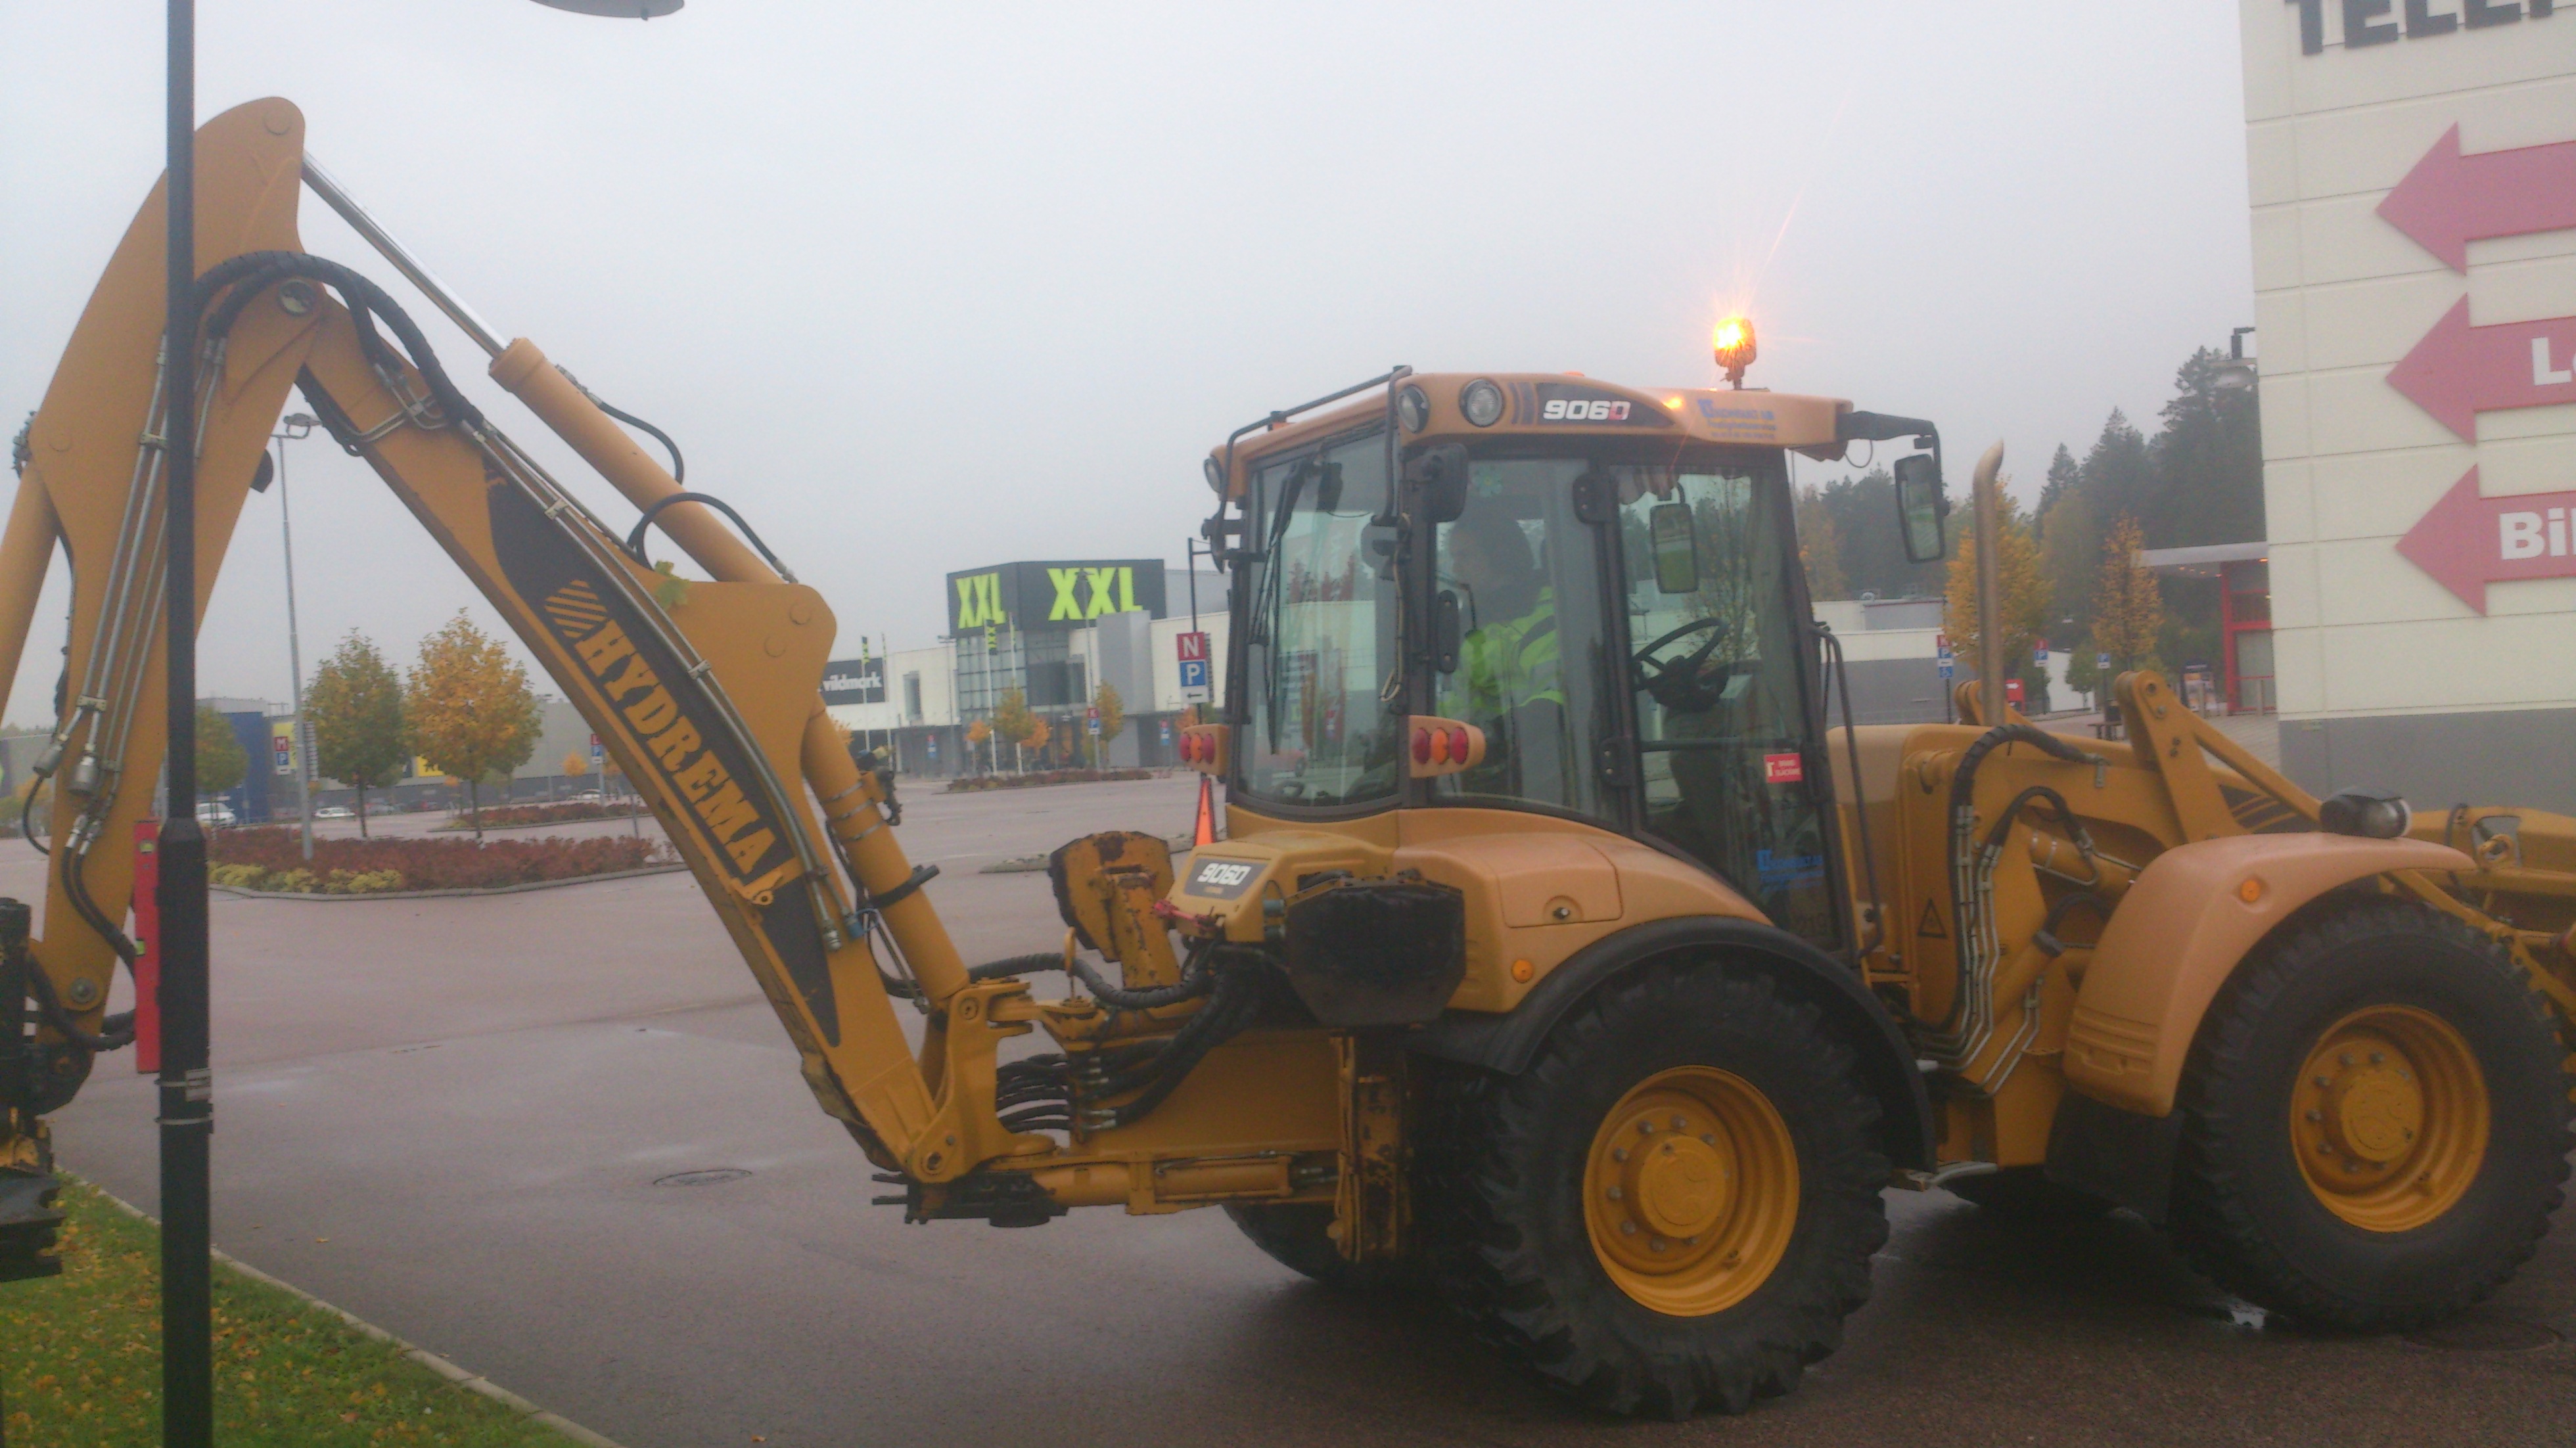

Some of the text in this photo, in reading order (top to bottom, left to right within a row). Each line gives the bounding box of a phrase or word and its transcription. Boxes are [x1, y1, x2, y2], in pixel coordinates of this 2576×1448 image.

[2531, 336, 2576, 386] L
[2499, 507, 2576, 560] Bi
[955, 572, 1006, 629] XXL
[1047, 567, 1143, 621] XXL
[1183, 635, 1199, 658] N
[1187, 664, 1201, 685] P
[575, 620, 776, 874] HYDREMA
